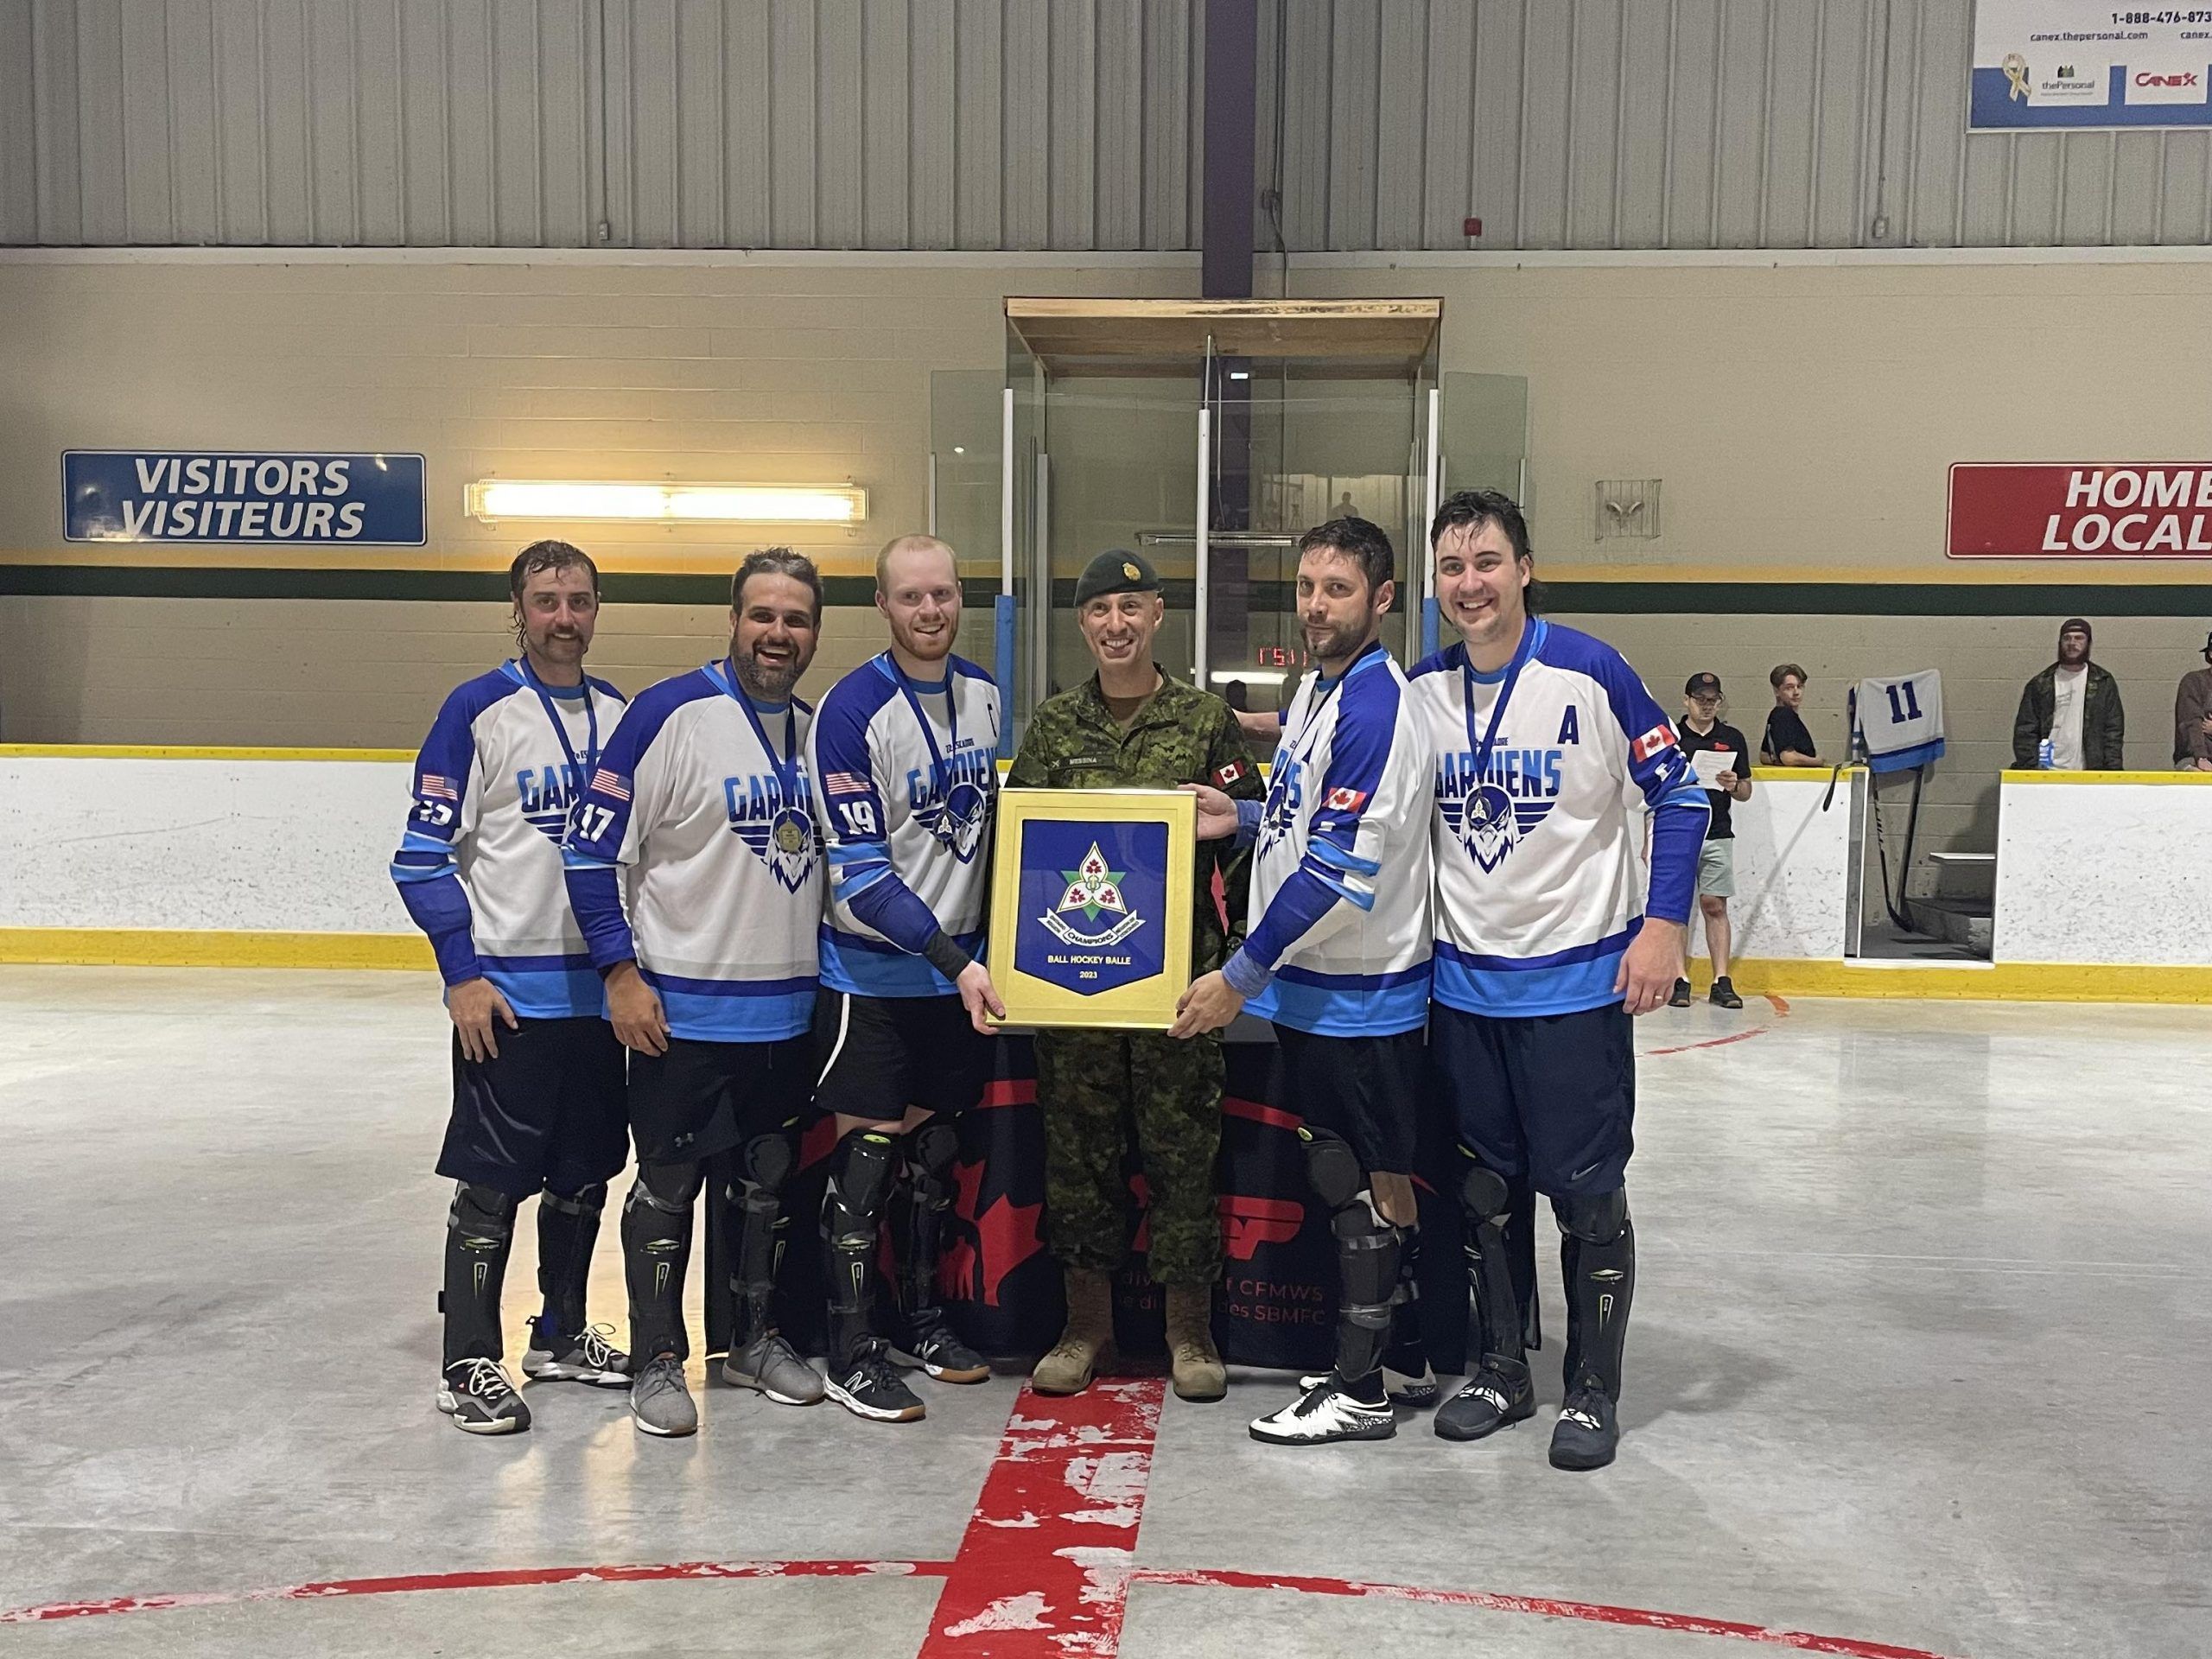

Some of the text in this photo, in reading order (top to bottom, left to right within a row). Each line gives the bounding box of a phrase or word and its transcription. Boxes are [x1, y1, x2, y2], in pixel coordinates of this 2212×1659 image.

[2031, 30, 2148, 41] canex.thepersonal.com
[2112, 11, 2212, 24] 1-888-476-873
[135, 458, 350, 496] VISITORS
[2065, 470, 2212, 508] HOME
[122, 500, 365, 538] VISITEURS
[2042, 513, 2212, 551] LOCAL
[1885, 681, 1923, 723] 11
[1558, 705, 1580, 745] A
[580, 803, 615, 843] 17
[839, 801, 877, 835] 19
[1067, 932, 1114, 944] CHAMPIONS
[1047, 955, 1131, 965] BALL HOCKEY BALLE
[1240, 1280, 1324, 1301] CFMWS
